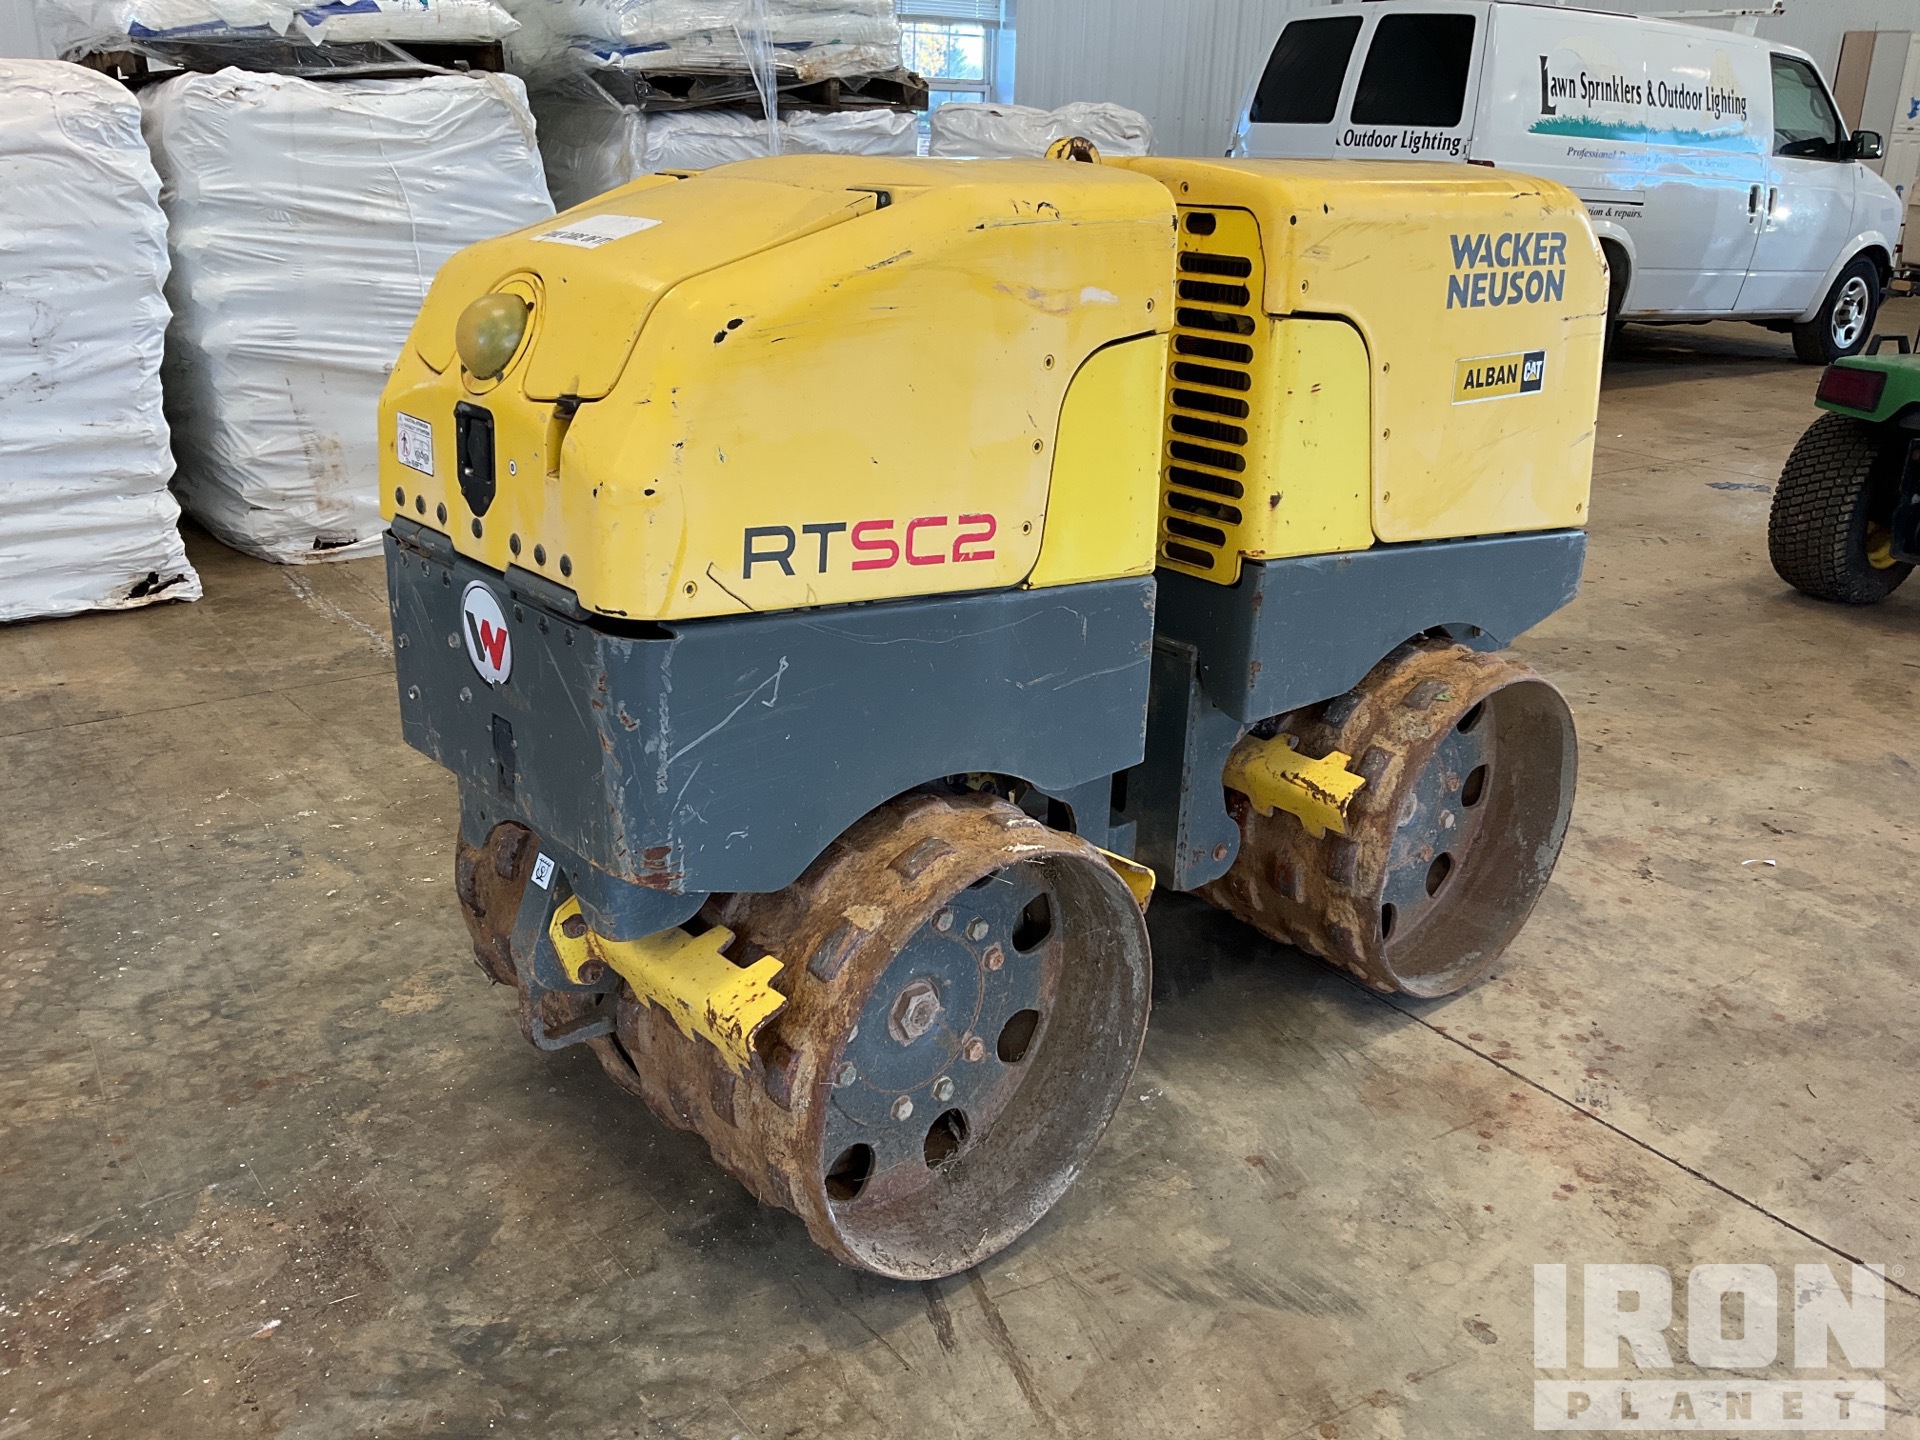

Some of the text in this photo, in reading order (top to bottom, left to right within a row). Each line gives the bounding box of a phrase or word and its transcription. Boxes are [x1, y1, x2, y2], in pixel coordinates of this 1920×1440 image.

[1539, 54, 1747, 121] Lawn Sprinklers & Outdoor Lighting
[1343, 129, 1398, 148] Outdoor
[1400, 130, 1461, 156] Lighting
[1566, 146, 1617, 160] Professional
[1588, 207, 1603, 216] tion
[1614, 208, 1643, 219] repairs.
[1450, 232, 1567, 269] WACKER
[1446, 269, 1566, 309] NEUSON
[1463, 360, 1543, 390] ALBAN CAT
